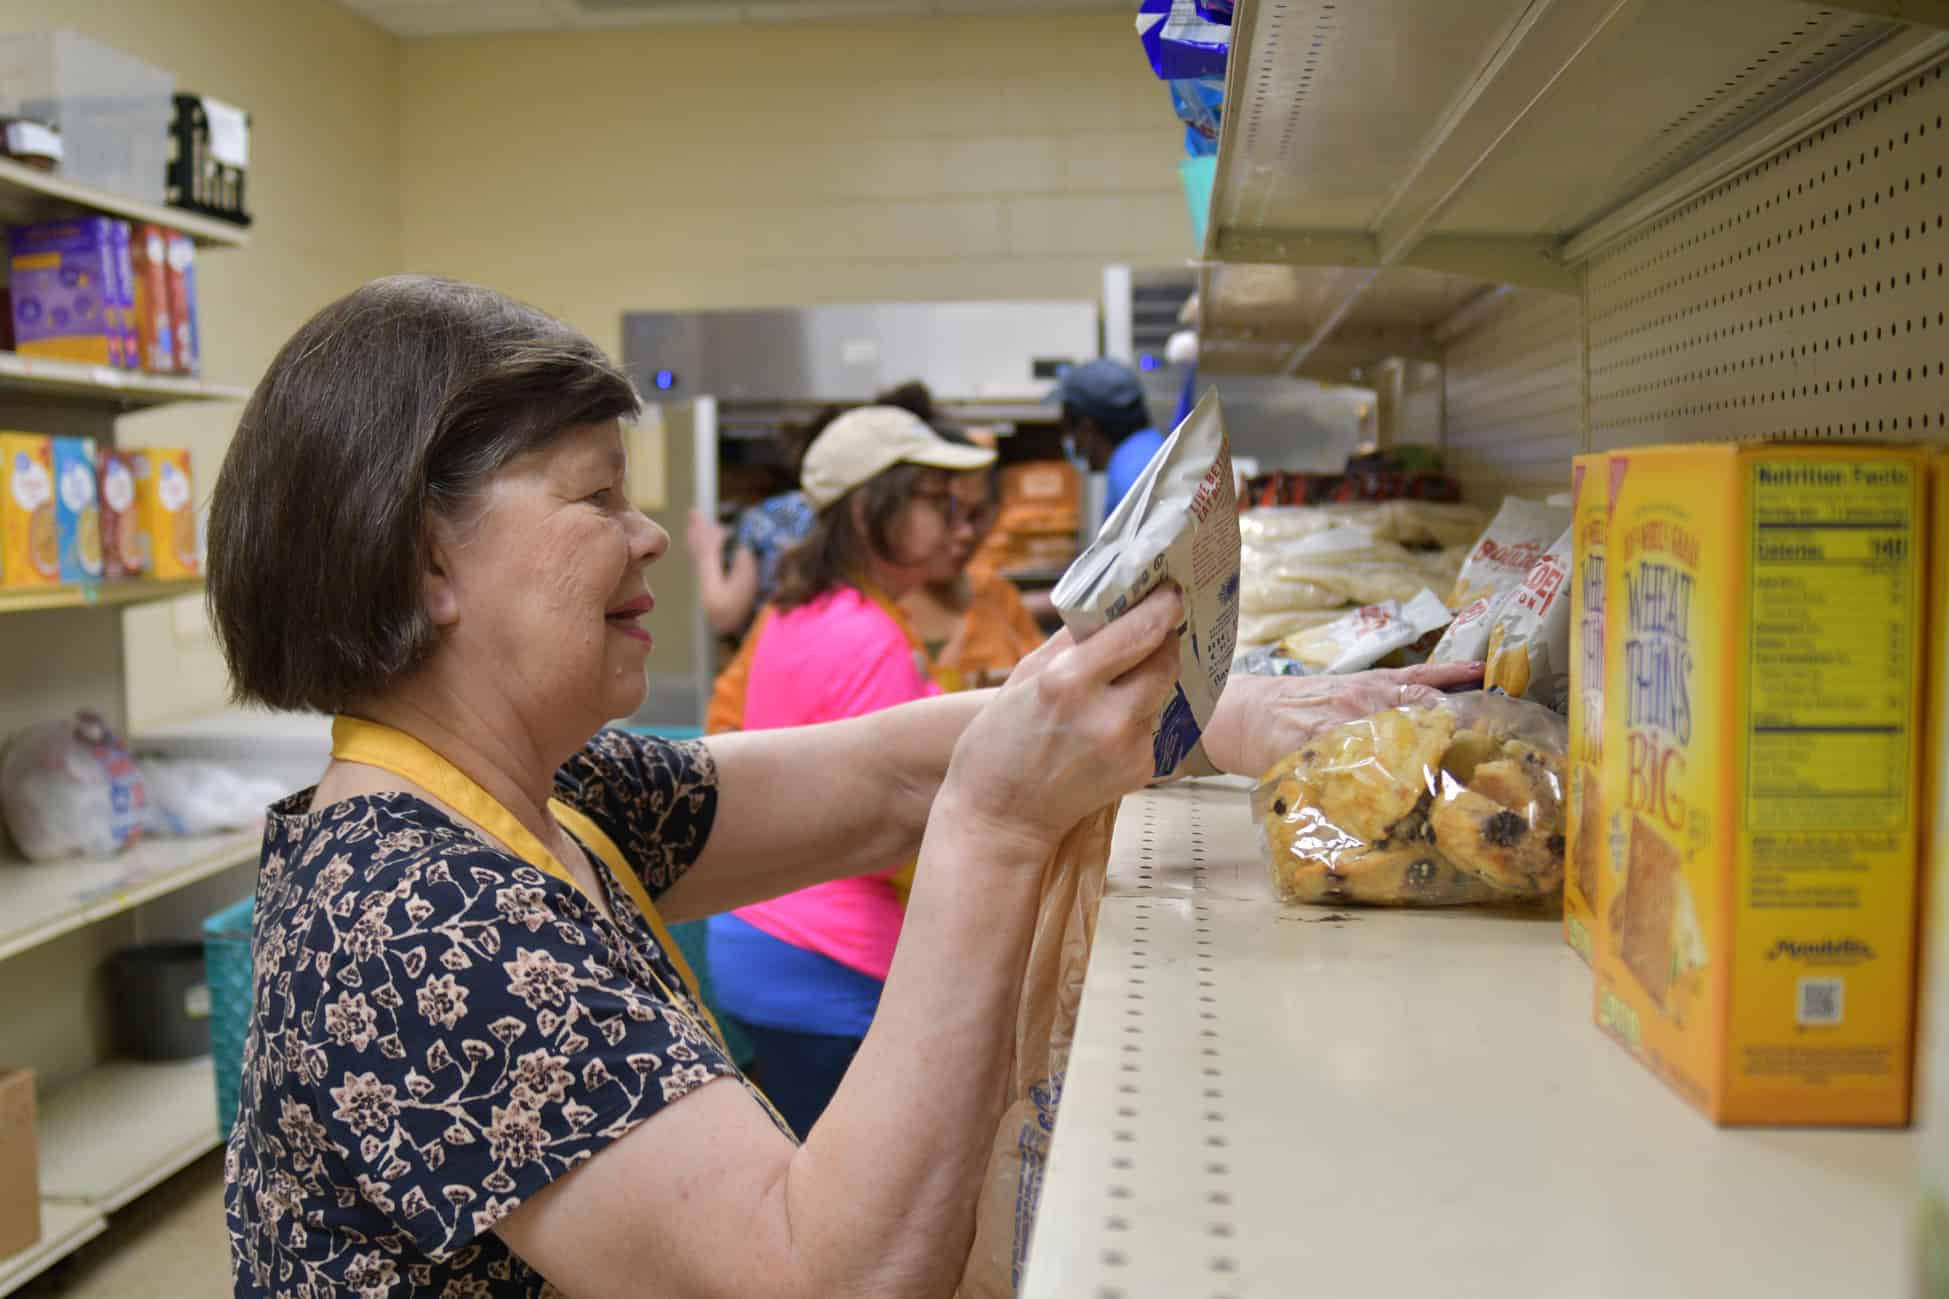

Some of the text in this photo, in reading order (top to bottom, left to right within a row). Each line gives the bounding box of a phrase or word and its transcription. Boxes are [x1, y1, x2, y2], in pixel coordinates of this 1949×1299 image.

[1758, 467, 1842, 487] Nutrition
[1624, 560, 1697, 644] WHEAT
[1624, 637, 1695, 748] THINS
[1624, 730, 1688, 832] BIG
